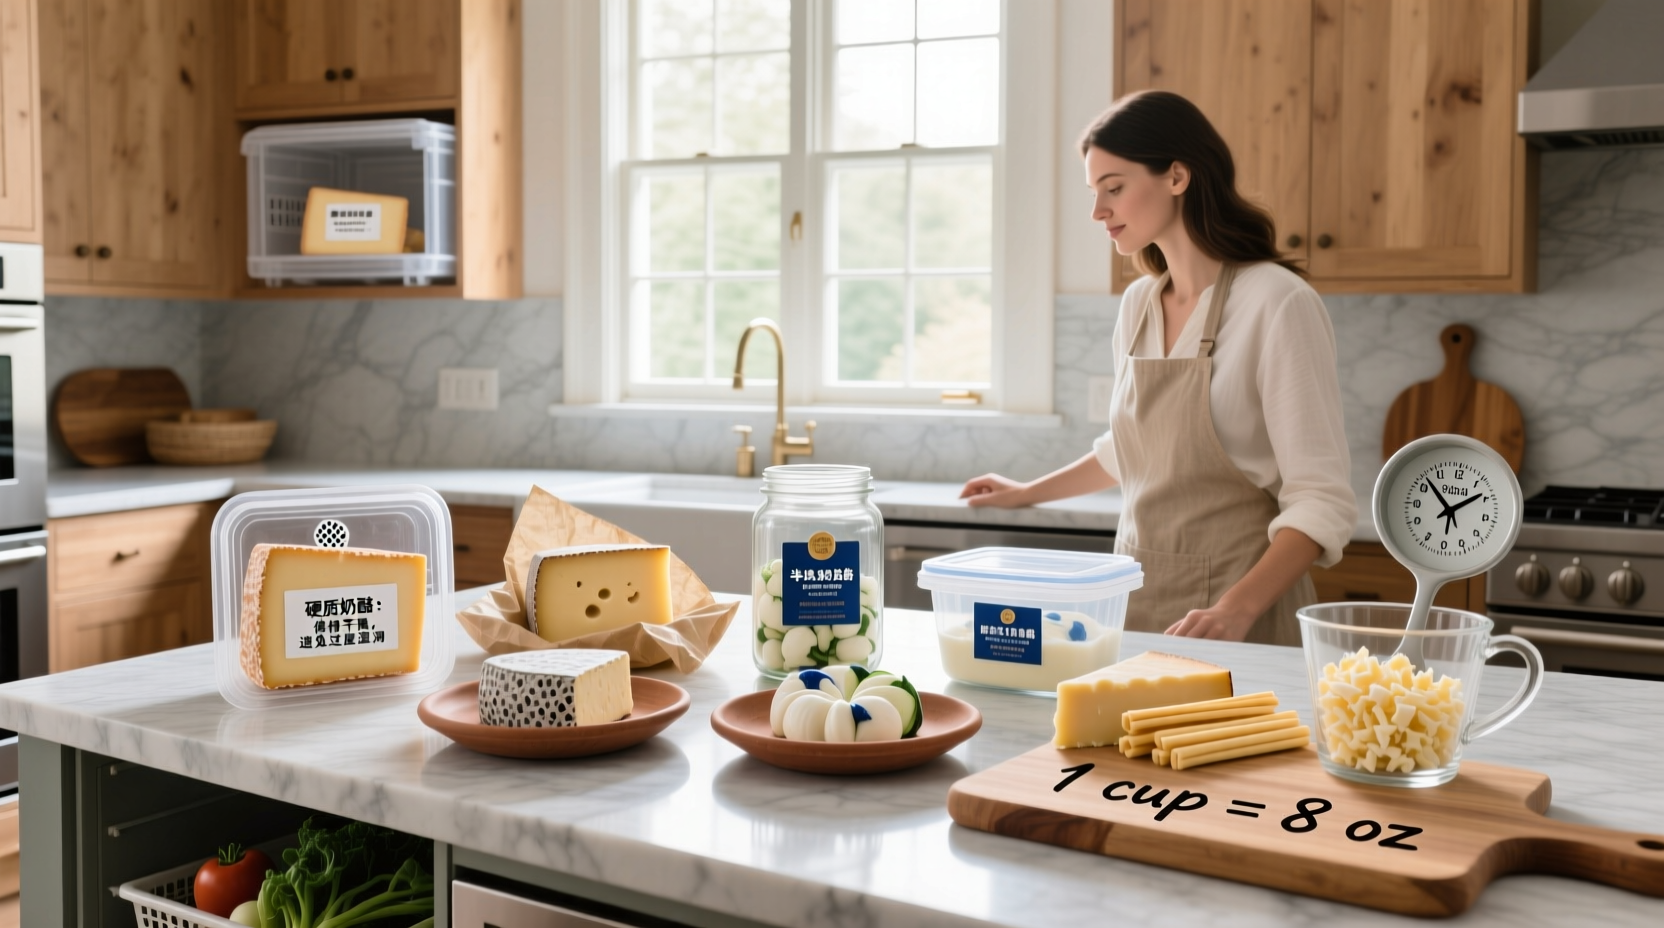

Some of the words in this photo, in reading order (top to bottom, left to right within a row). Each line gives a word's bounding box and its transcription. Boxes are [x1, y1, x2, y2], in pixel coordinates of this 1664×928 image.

[1053, 762, 1095, 792] 1
[1101, 780, 1208, 822] cup
[1226, 799, 1266, 818] =
[1280, 797, 1333, 833] 8
[1345, 819, 1424, 851] oz
